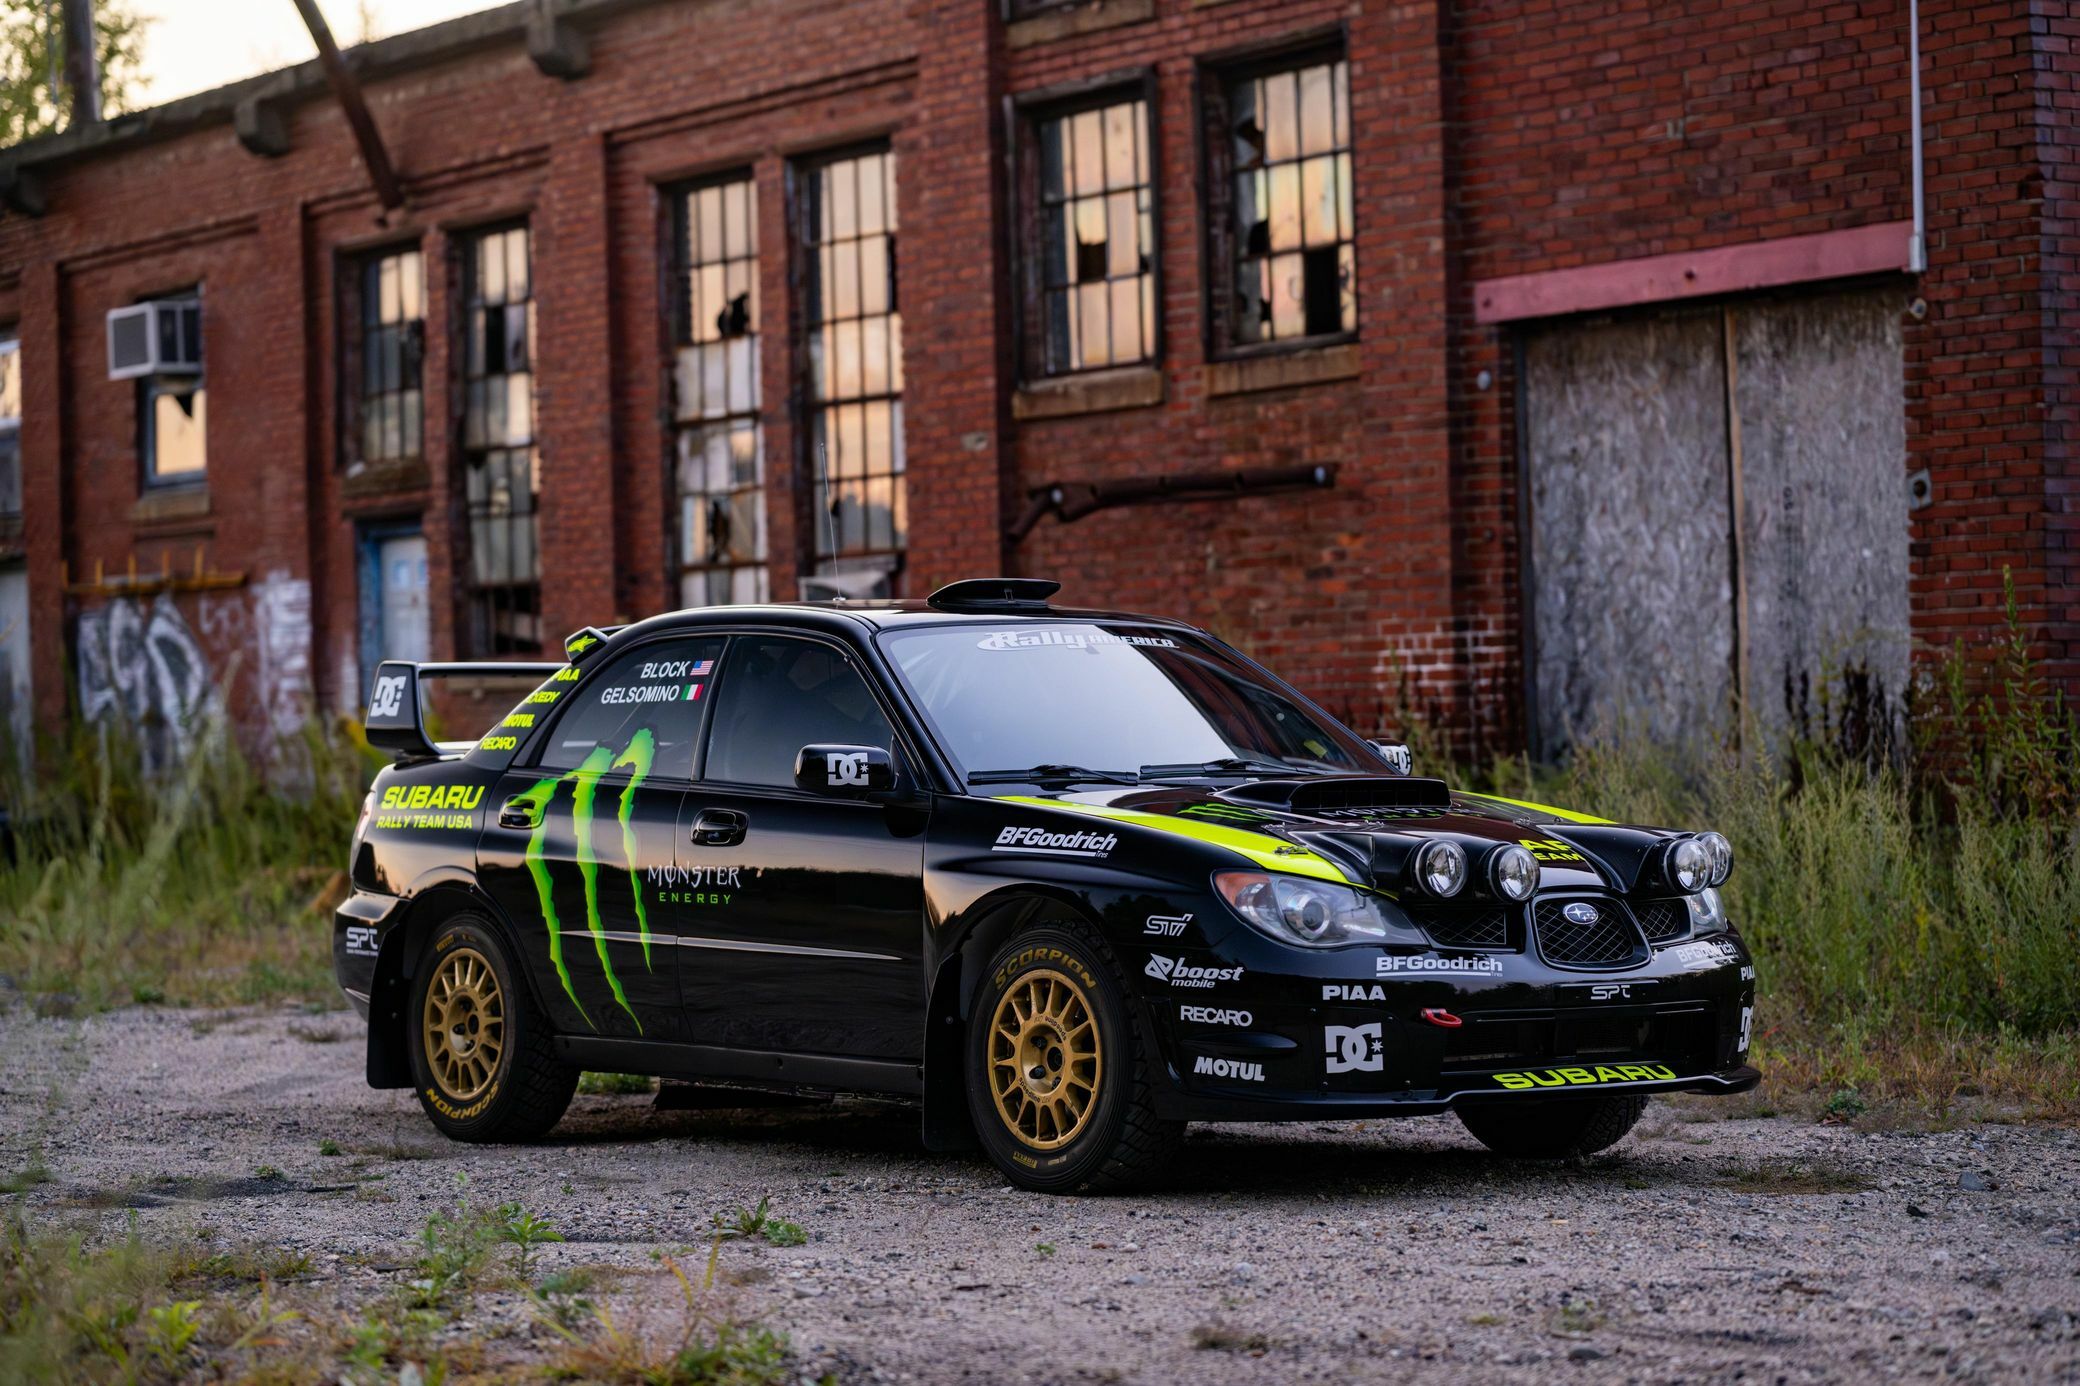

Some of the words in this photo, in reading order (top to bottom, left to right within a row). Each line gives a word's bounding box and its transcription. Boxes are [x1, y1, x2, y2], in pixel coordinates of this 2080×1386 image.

[984, 630, 1091, 649] Rally
[641, 660, 691, 679] BLOCK
[370, 675, 406, 717] DC
[601, 684, 680, 705] GELSOMINO
[827, 752, 869, 786] DC
[381, 785, 485, 809] SUBARU
[376, 815, 412, 829] RALLY
[412, 815, 446, 829] TEAM
[446, 815, 473, 829] USA
[995, 826, 1118, 851] BFGoodrich
[648, 861, 741, 889] MONSTER
[659, 891, 731, 905] ENERGY
[995, 947, 1097, 989] SCORPION
[1171, 957, 1244, 982] boost
[1376, 956, 1503, 972] BFGoodrich
[1170, 978, 1216, 989] mobile
[1322, 985, 1387, 1001] PIAA
[1180, 1005, 1252, 1027] RECARO
[1324, 1022, 1384, 1074] DC
[1193, 1056, 1266, 1082] MOTUL
[1492, 1064, 1678, 1090] SUBARU
